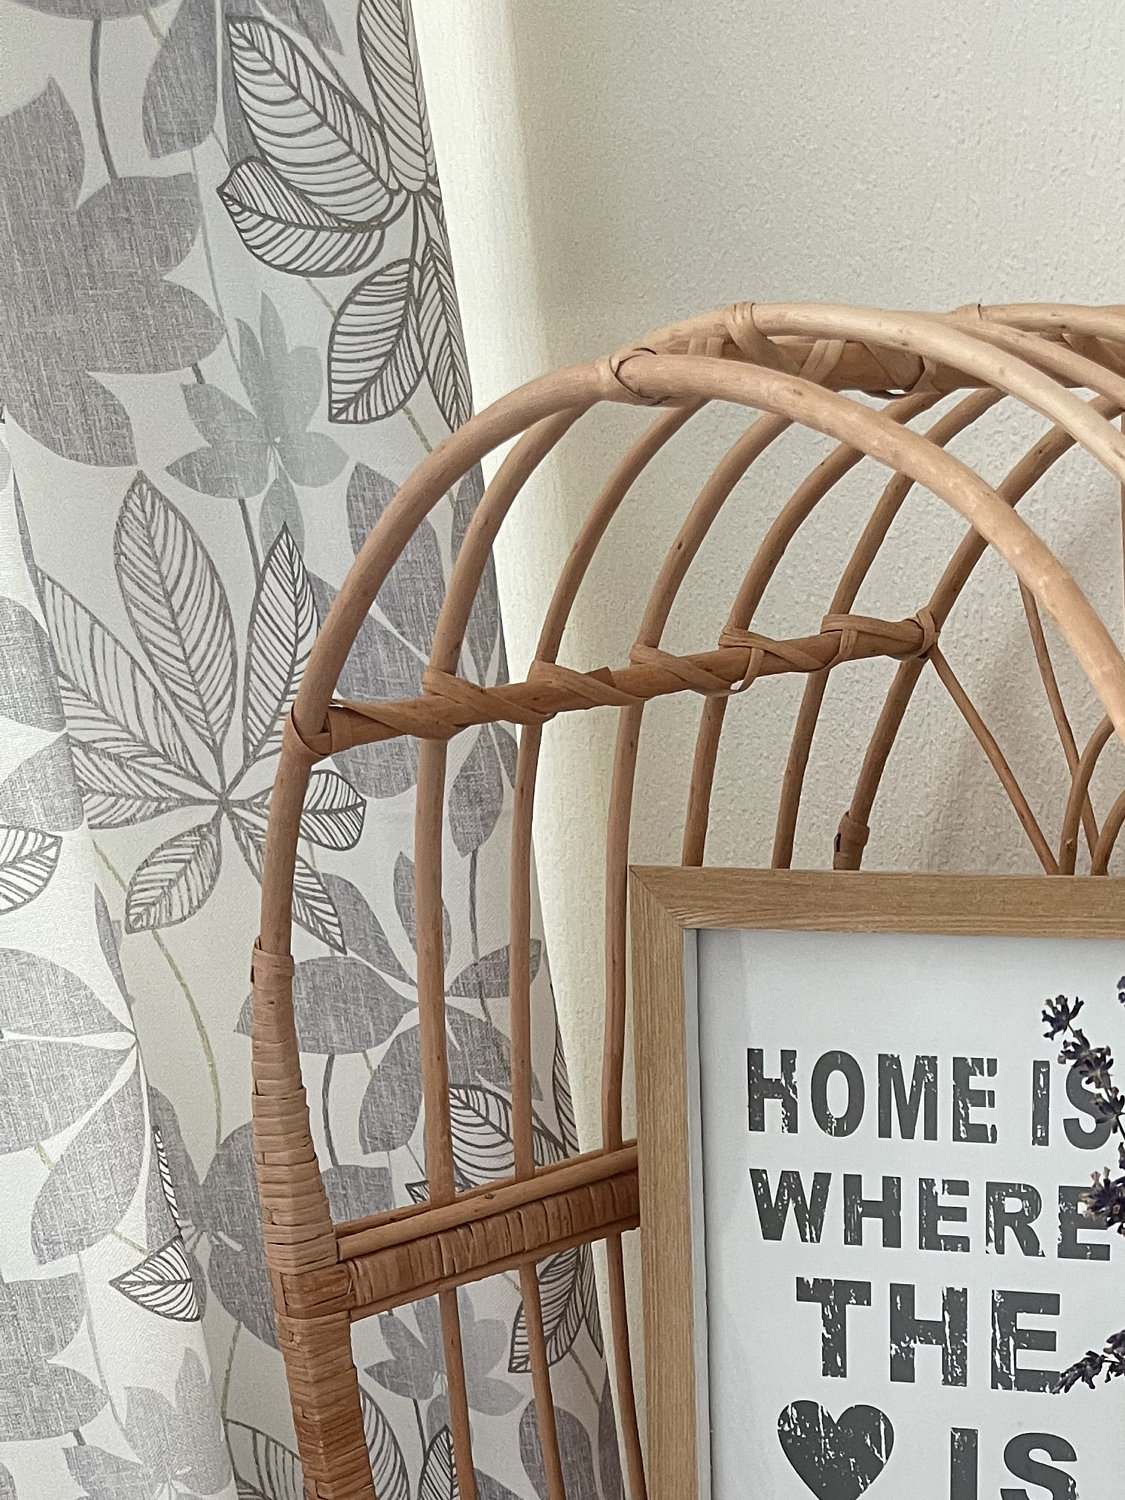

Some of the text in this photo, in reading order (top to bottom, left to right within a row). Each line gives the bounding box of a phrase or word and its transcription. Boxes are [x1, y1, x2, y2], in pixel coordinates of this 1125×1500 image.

[747, 1048, 1112, 1150] HOME IS
[749, 1168, 1111, 1261] WHERE
[796, 1277, 1061, 1394] THE
